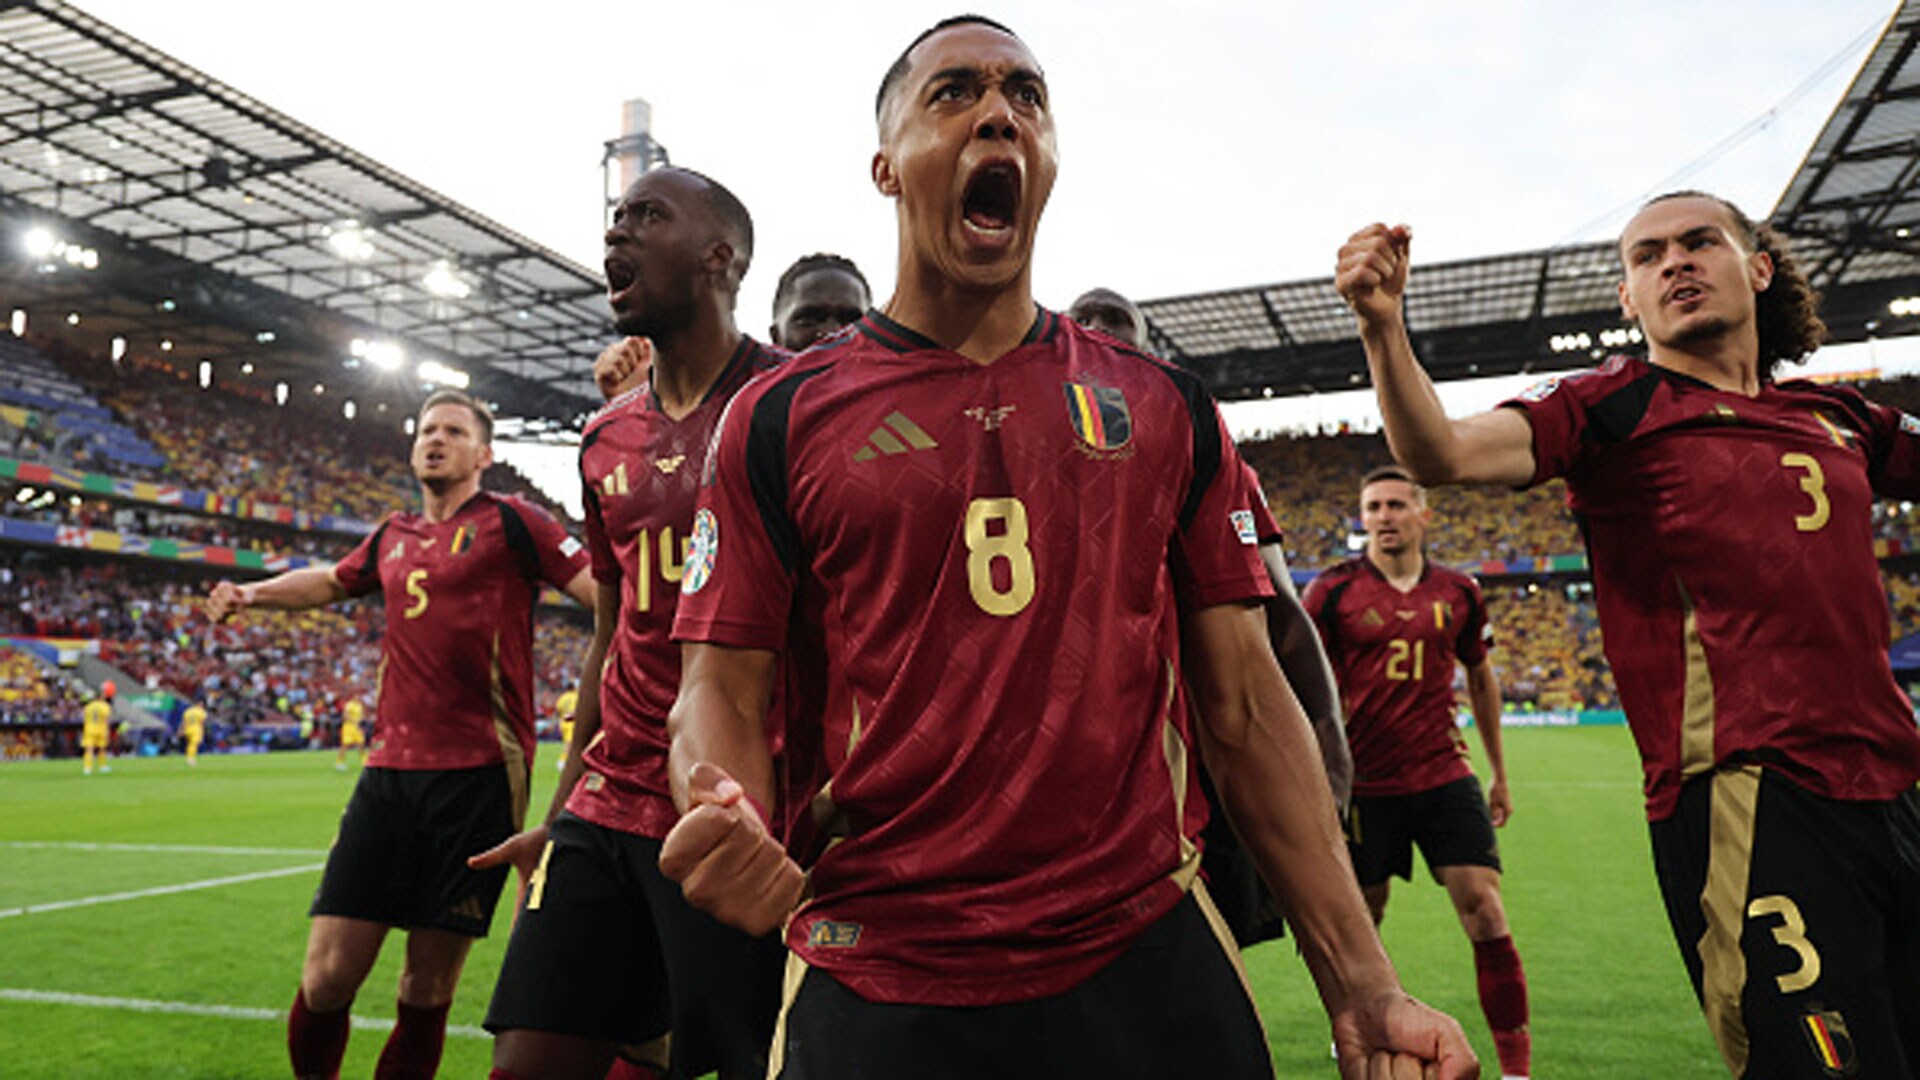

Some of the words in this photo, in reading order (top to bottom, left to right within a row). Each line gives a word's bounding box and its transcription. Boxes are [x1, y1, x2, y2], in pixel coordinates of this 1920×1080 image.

[1781, 452, 1831, 531] 3
[404, 569, 429, 619] 5
[964, 497, 1036, 616] 8
[1386, 639, 1424, 680] 21
[1748, 894, 1821, 993] 3
